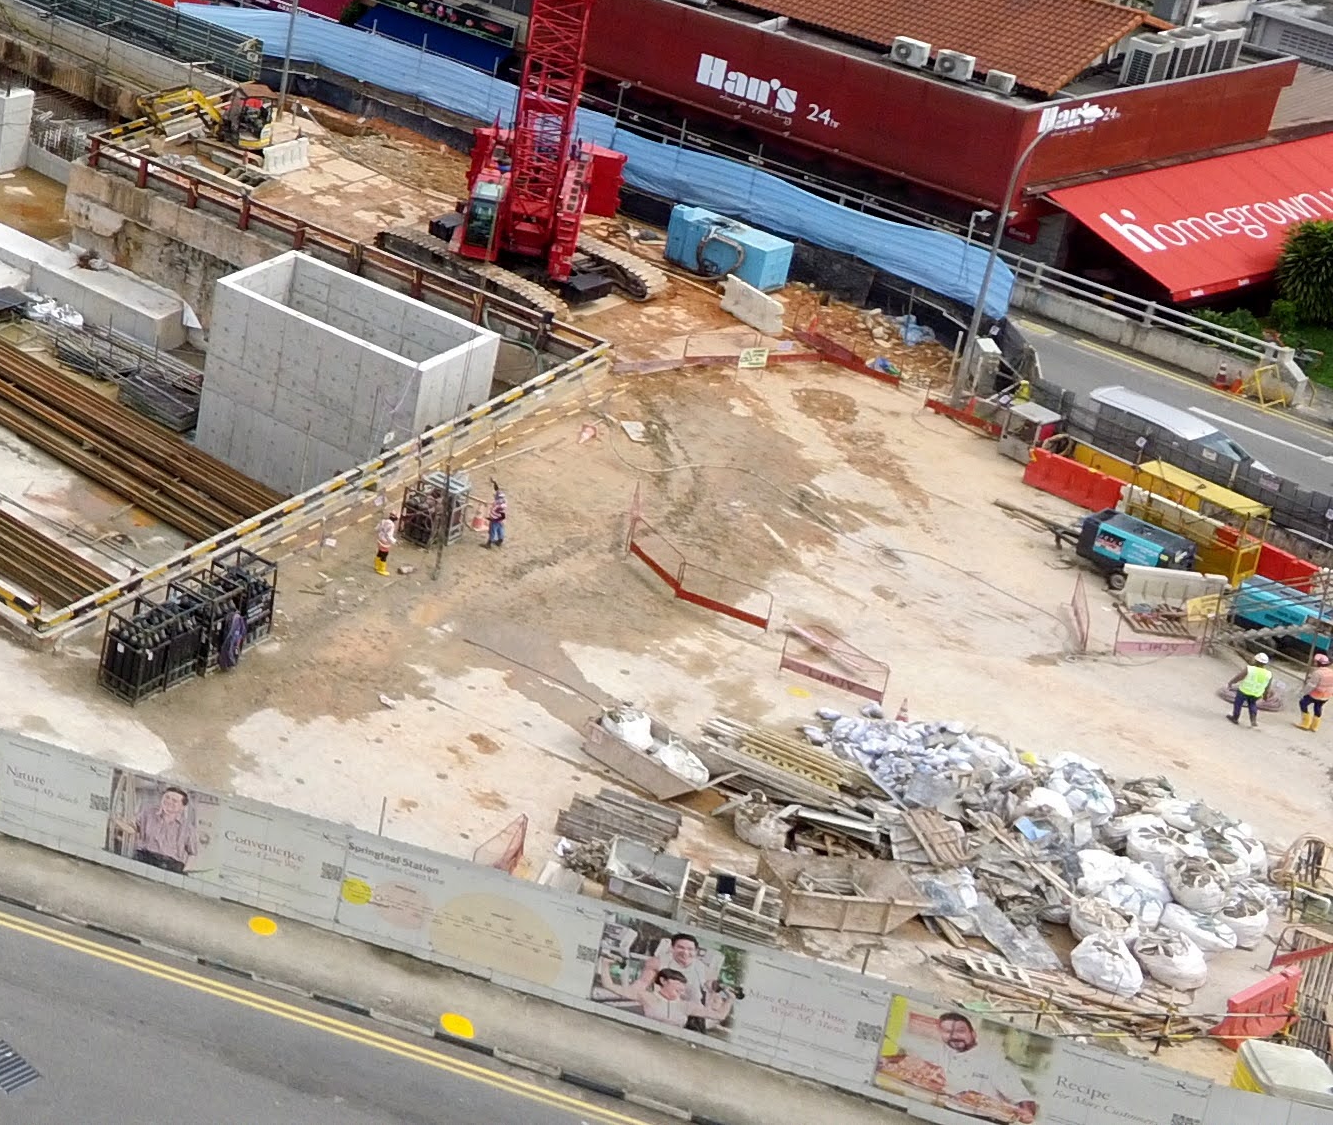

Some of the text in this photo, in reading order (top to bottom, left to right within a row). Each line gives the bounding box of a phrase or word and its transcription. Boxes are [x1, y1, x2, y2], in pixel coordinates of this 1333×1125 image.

[696, 53, 798, 113] Han's
[1099, 192, 1321, 253] homegrown
[6, 763, 46, 785] Nature
[224, 829, 306, 863] Convenience
[348, 841, 401, 865] Springleaf
[401, 857, 440, 875] Station
[1056, 1075, 1111, 1101] Recipe
